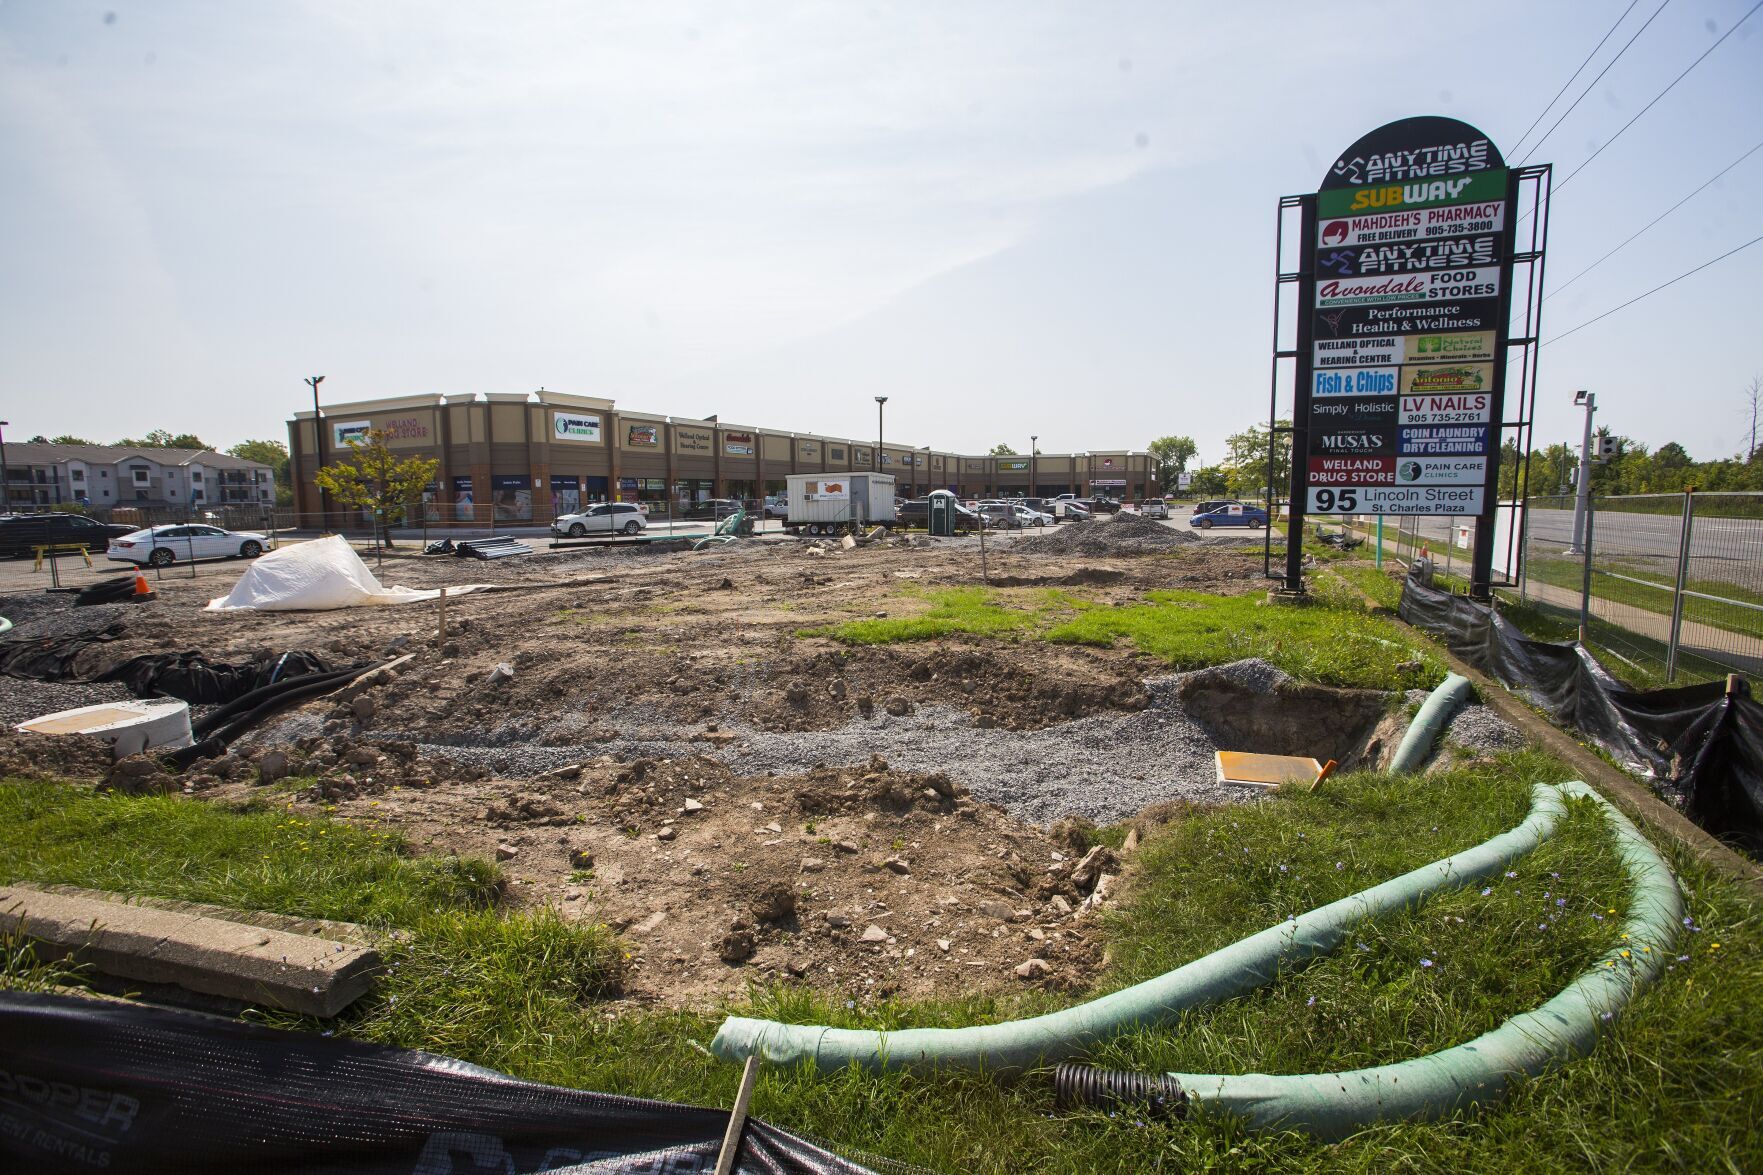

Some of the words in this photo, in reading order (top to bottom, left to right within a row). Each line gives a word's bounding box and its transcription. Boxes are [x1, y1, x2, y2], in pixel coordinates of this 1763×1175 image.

[1365, 139, 1488, 171] ANYTIME
[1350, 176, 1473, 211] SUBWAY
[1352, 212, 1421, 232] MAHDIEH'S
[1428, 203, 1501, 224] PHARMACY
[1357, 231, 1377, 243] FREE
[1378, 228, 1418, 241] DELIVERY
[1425, 220, 1493, 236] 905-735-3800
[1358, 237, 1494, 263] ANYTIME
[1430, 270, 1477, 285] FOOD
[1428, 283, 1496, 299] STORES
[1324, 297, 1366, 305] CONVENIENCE
[1368, 304, 1460, 320] Performance
[1351, 321, 1398, 334] Health
[1400, 320, 1413, 331] &
[1416, 316, 1481, 329] Wellness
[1318, 339, 1358, 351] WELLAND
[1359, 338, 1396, 349] OPTICAL
[1443, 336, 1483, 345] Natural
[1320, 355, 1357, 366] HEARING
[1358, 353, 1392, 363] CENTRE
[1316, 372, 1341, 394] Fish
[1344, 379, 1353, 393] &
[1356, 371, 1394, 394] Chips
[1313, 403, 1349, 415] Simply
[1354, 402, 1395, 413] Holistic
[1402, 397, 1425, 412] LV
[1430, 396, 1486, 412] NAILS
[1407, 414, 1428, 423] 905
[1431, 412, 1481, 422] 735-2761
[1402, 428, 1430, 439] COIN
[1432, 427, 1486, 438] LAUNDRY
[1322, 434, 1383, 448] MUSA'S
[1403, 443, 1426, 453] DRY
[1427, 442, 1483, 453] CLEANING
[1323, 459, 1382, 470] WELLAND
[1425, 463, 1451, 471] PAIN
[1454, 463, 1483, 471] CARE
[1309, 471, 1347, 483] DRUG
[1351, 471, 1395, 483] STORE
[1315, 488, 1358, 512] 95
[1364, 488, 1419, 501] Lincoln
[1425, 488, 1475, 501] Street
[1371, 504, 1388, 512] St.
[1389, 504, 1433, 513] Charles
[1435, 504, 1465, 513] Plaza
